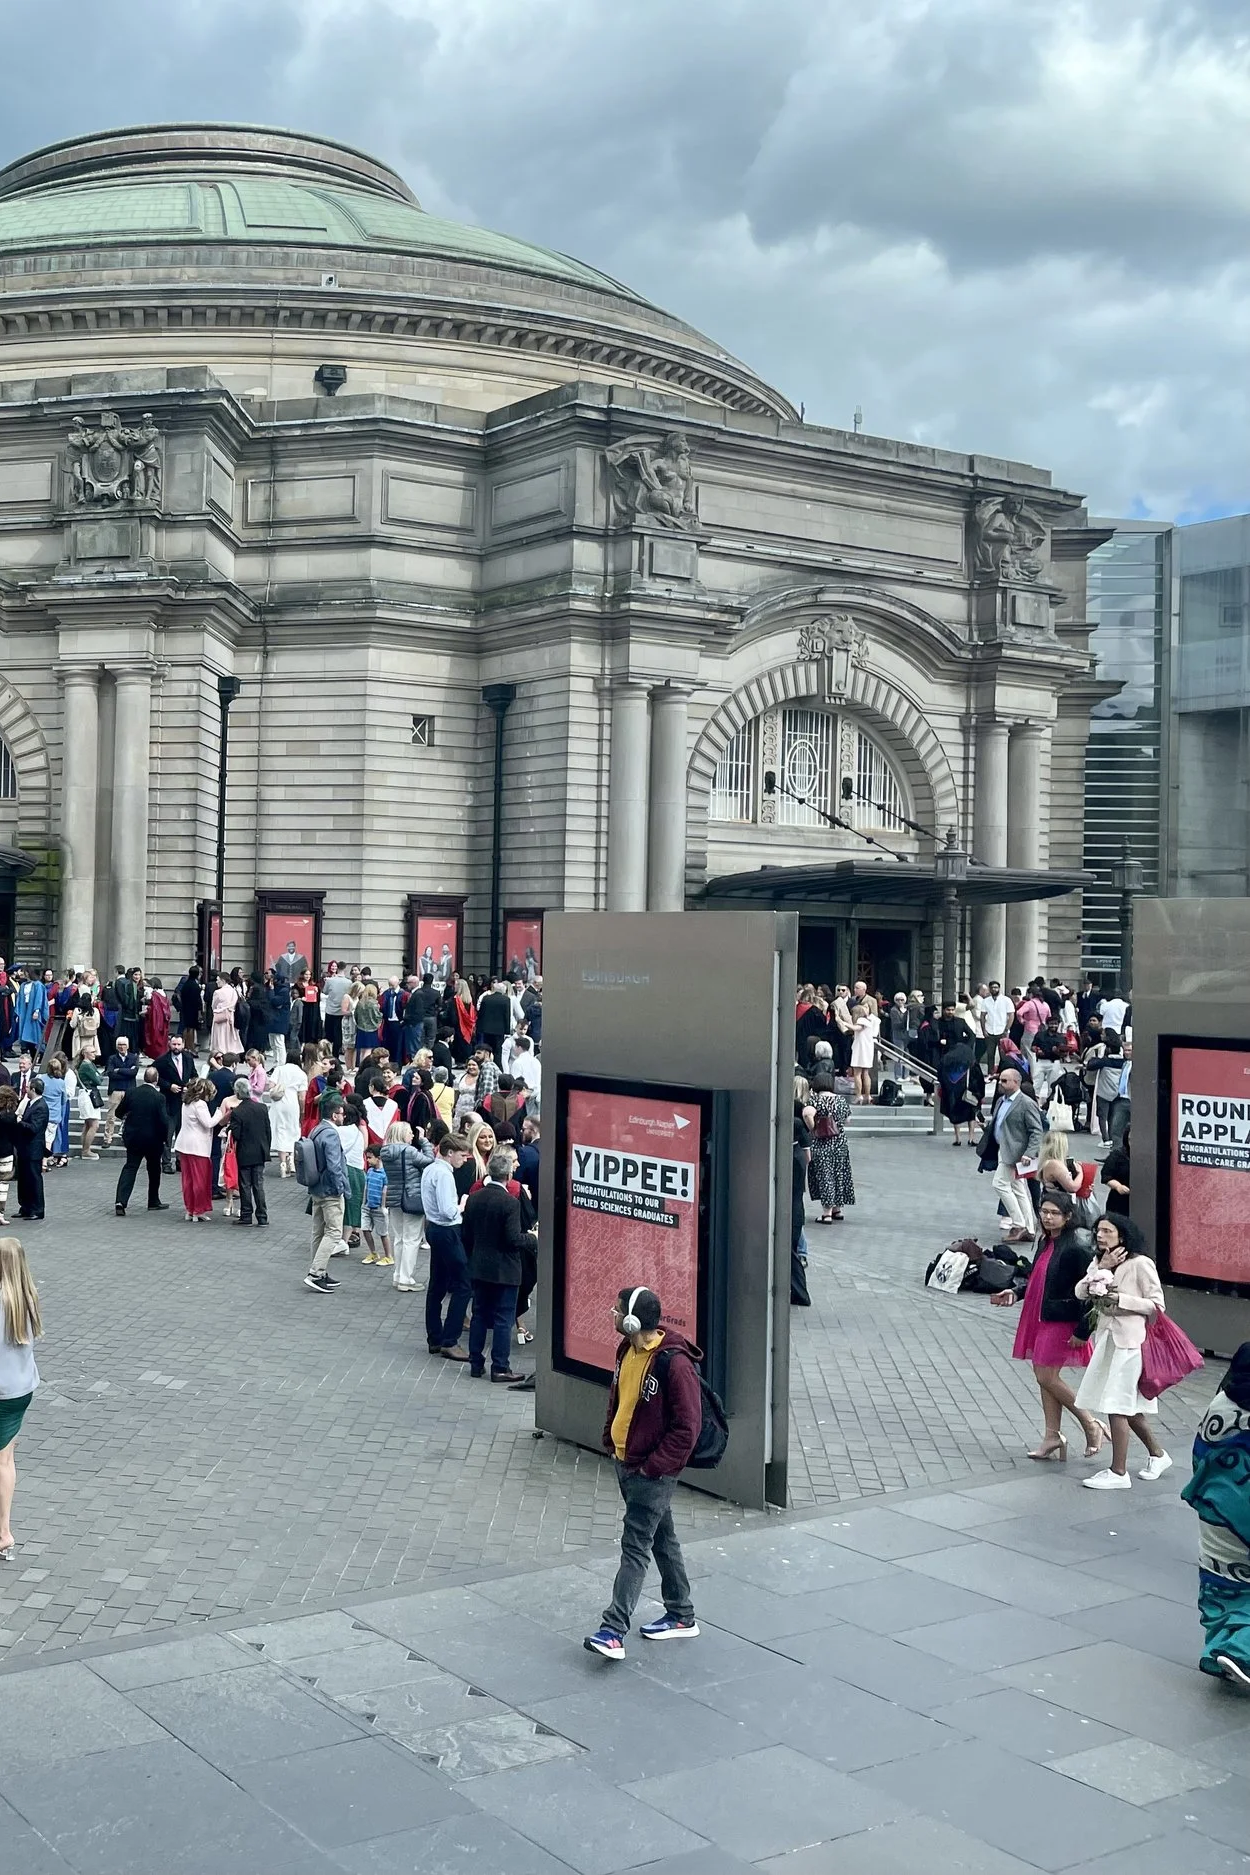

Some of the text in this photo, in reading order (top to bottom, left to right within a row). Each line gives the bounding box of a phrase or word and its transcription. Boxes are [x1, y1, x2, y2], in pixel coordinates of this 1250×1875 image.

[1181, 1098, 1250, 1121] ROUN
[1180, 1143, 1250, 1158] CONGRATULATIONS
[1187, 1155, 1213, 1165] SOCIAL
[1215, 1158, 1235, 1168] CARE
[574, 1149, 689, 1198] YIPPEE!
[573, 1183, 660, 1208] CONGRATULATIONS TO OUR
[572, 1196, 674, 1224] APPLIED SCIENCES GRADUATES
